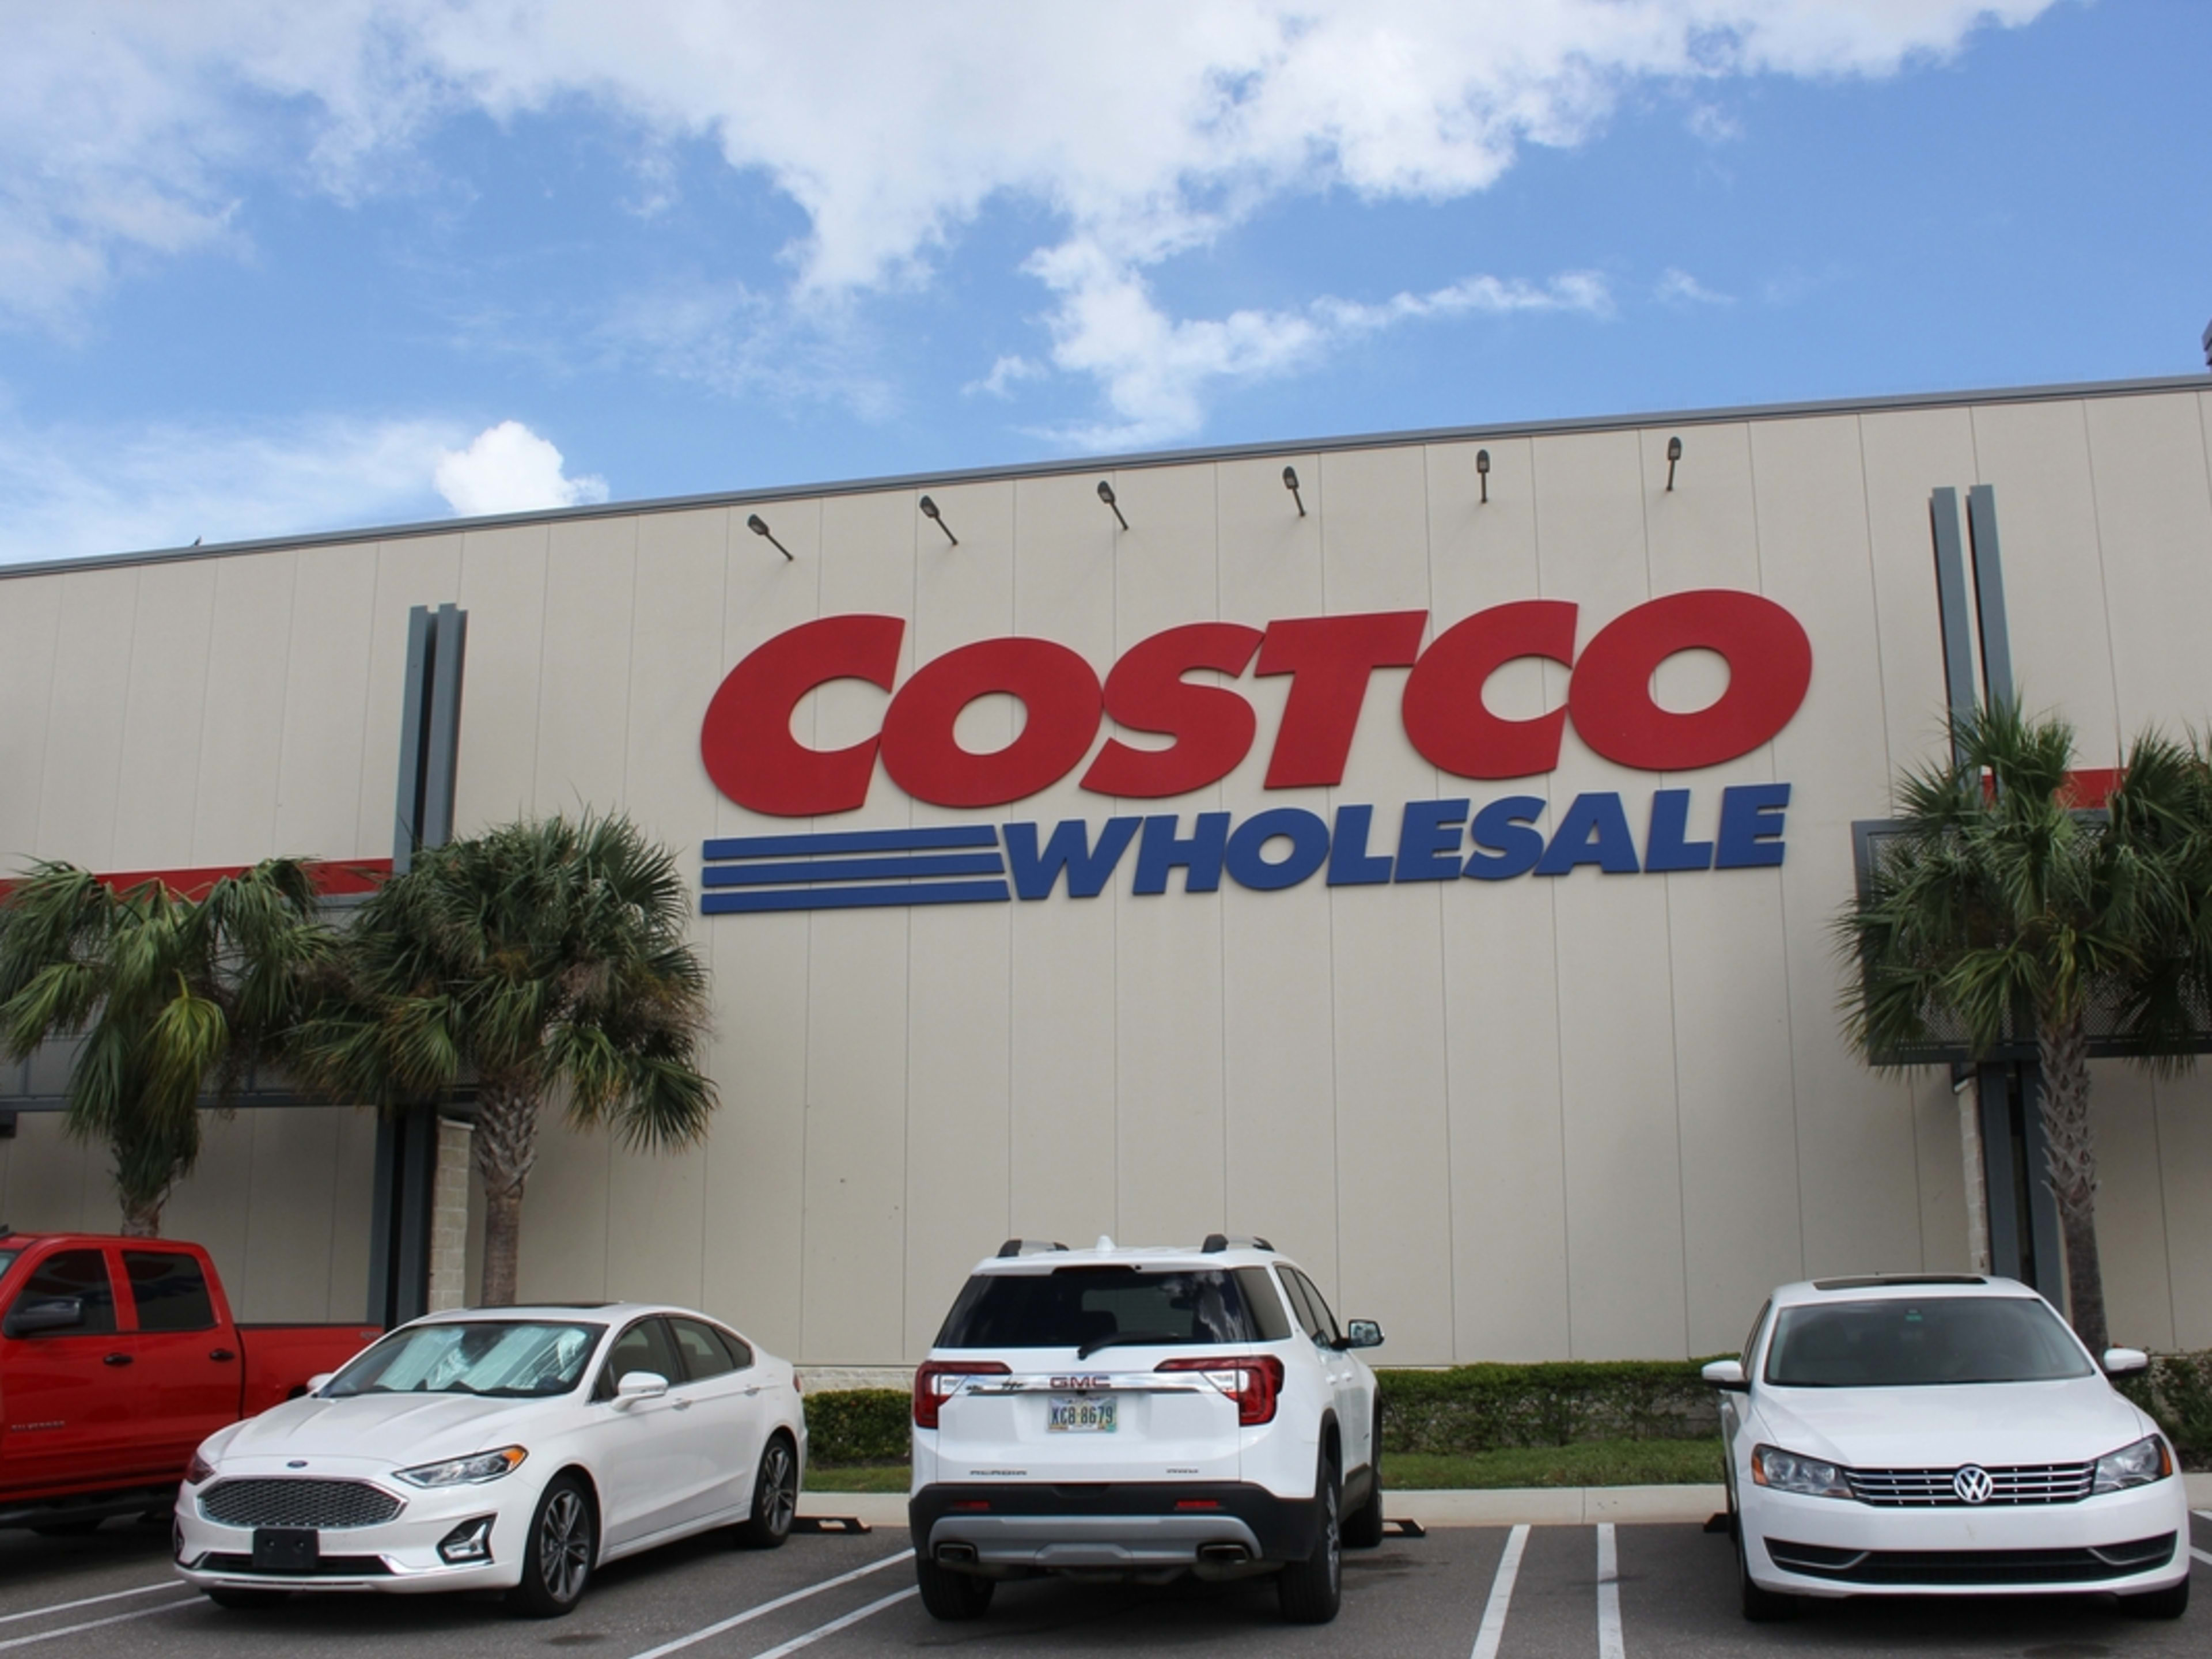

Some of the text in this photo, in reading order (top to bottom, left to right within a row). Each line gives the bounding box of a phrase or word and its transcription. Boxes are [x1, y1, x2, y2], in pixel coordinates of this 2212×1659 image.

[702, 589, 1812, 817] COSTCO
[1003, 783, 1793, 900] WHOLESALE
[1050, 1376, 1111, 1388] GMC
[1081, 1406, 1113, 1424] 8679
